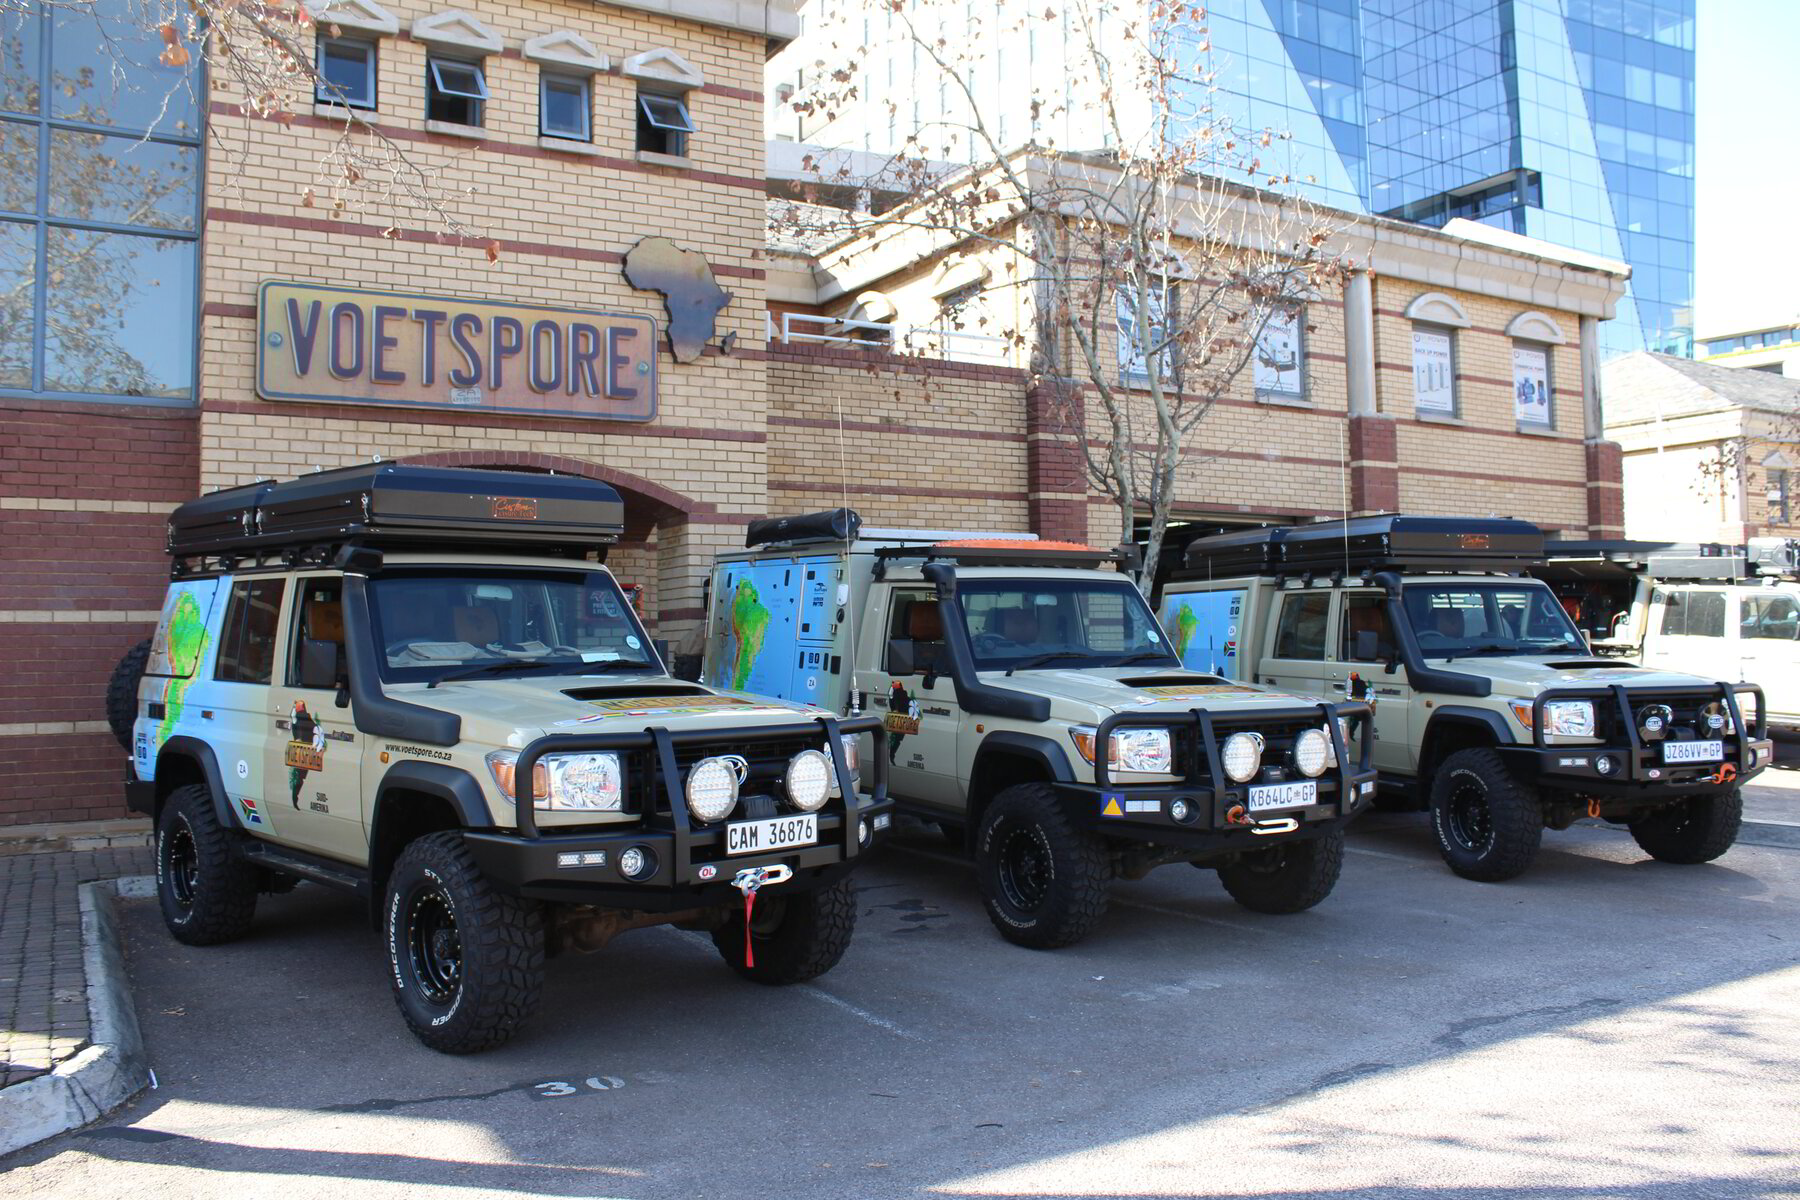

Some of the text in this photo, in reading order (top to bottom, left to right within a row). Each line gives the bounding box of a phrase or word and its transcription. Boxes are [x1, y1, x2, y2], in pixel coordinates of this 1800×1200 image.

[284, 297, 639, 400] VOETSPORE
[384, 743, 453, 761] www.voetspore.co.za
[1666, 742, 1721, 760] JZ86VV GP
[1250, 784, 1315, 808] KB64LC GP
[729, 818, 813, 851] CAM 36876
[389, 892, 405, 989] DISCOVERER
